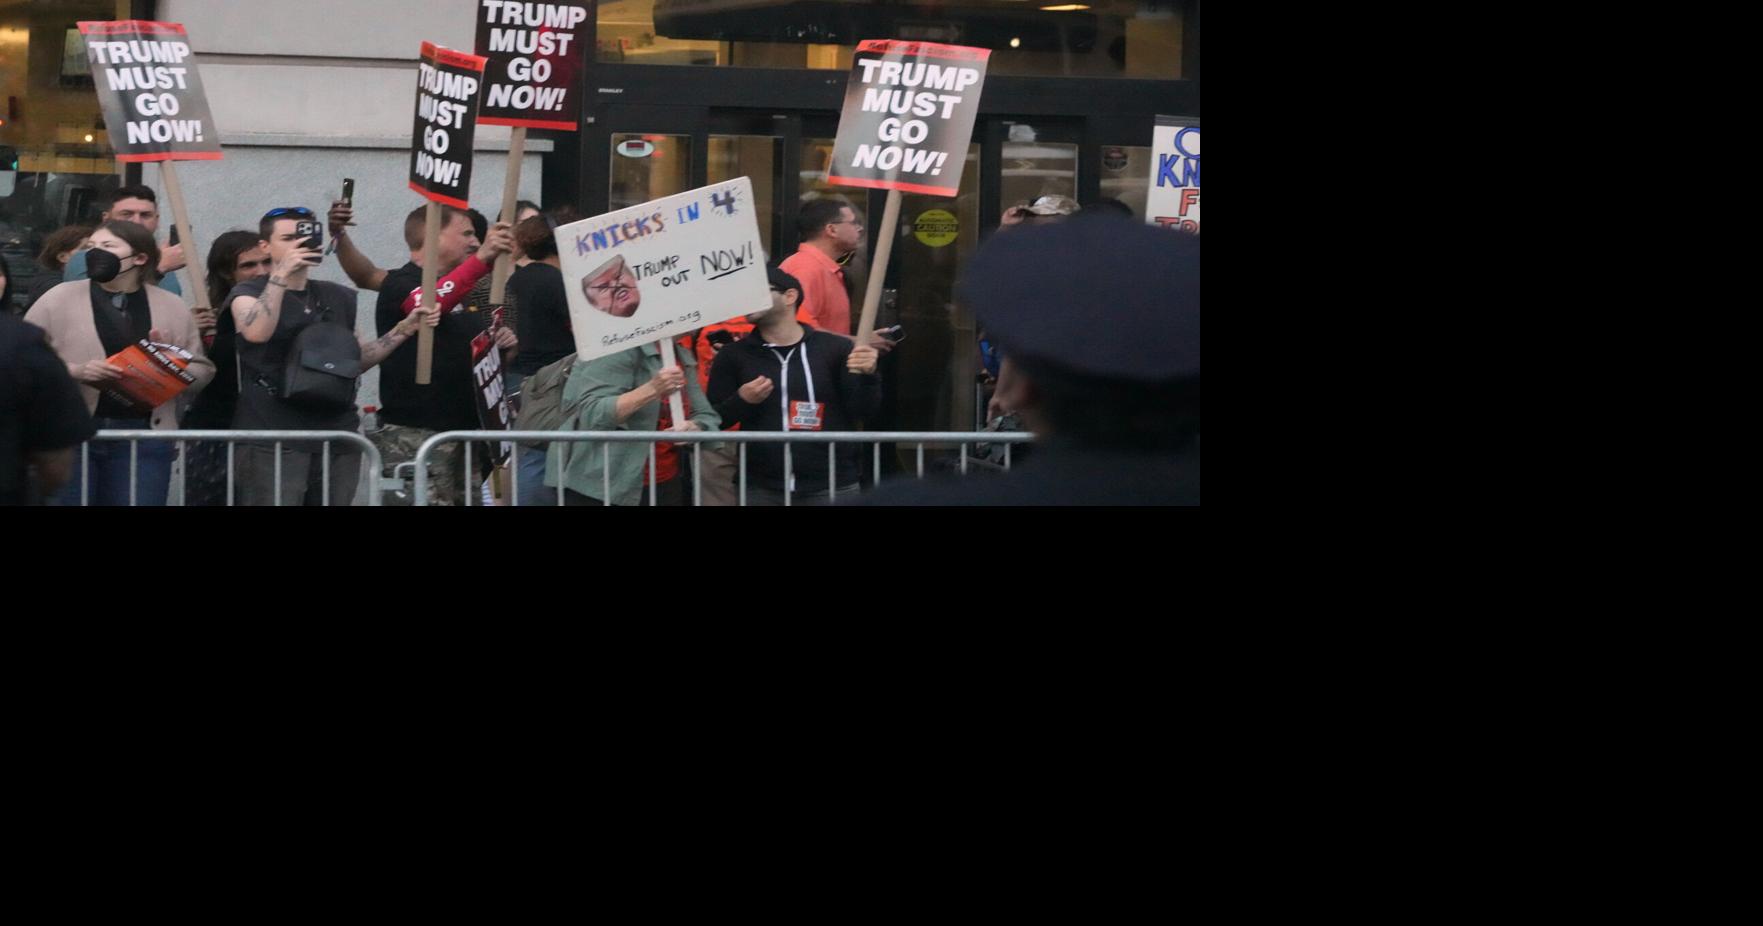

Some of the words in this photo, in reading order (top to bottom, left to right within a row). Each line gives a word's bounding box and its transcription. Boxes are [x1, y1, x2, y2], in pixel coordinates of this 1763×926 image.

[482, 0, 587, 29] TRUMP
[88, 40, 190, 64] TRUMP
[488, 28, 574, 56] MUST
[105, 66, 187, 91] MUST
[418, 62, 478, 101] TRUMP
[507, 57, 552, 83] GO
[858, 58, 979, 92] TRUMP
[135, 92, 179, 117] GO
[418, 93, 468, 129] MUST
[486, 83, 567, 111] NOW!
[862, 88, 962, 120] MUST
[126, 118, 203, 145] NOW!
[423, 125, 450, 154] GO
[878, 117, 929, 145] GO
[415, 150, 463, 187] NOW!
[851, 144, 949, 176] NOW!
[575, 212, 664, 256] KNICKS
[677, 201, 700, 225] IN
[711, 190, 735, 215] 4
[632, 255, 680, 281] TRUMP
[661, 269, 690, 288] OUT
[700, 241, 754, 275] NOW!
